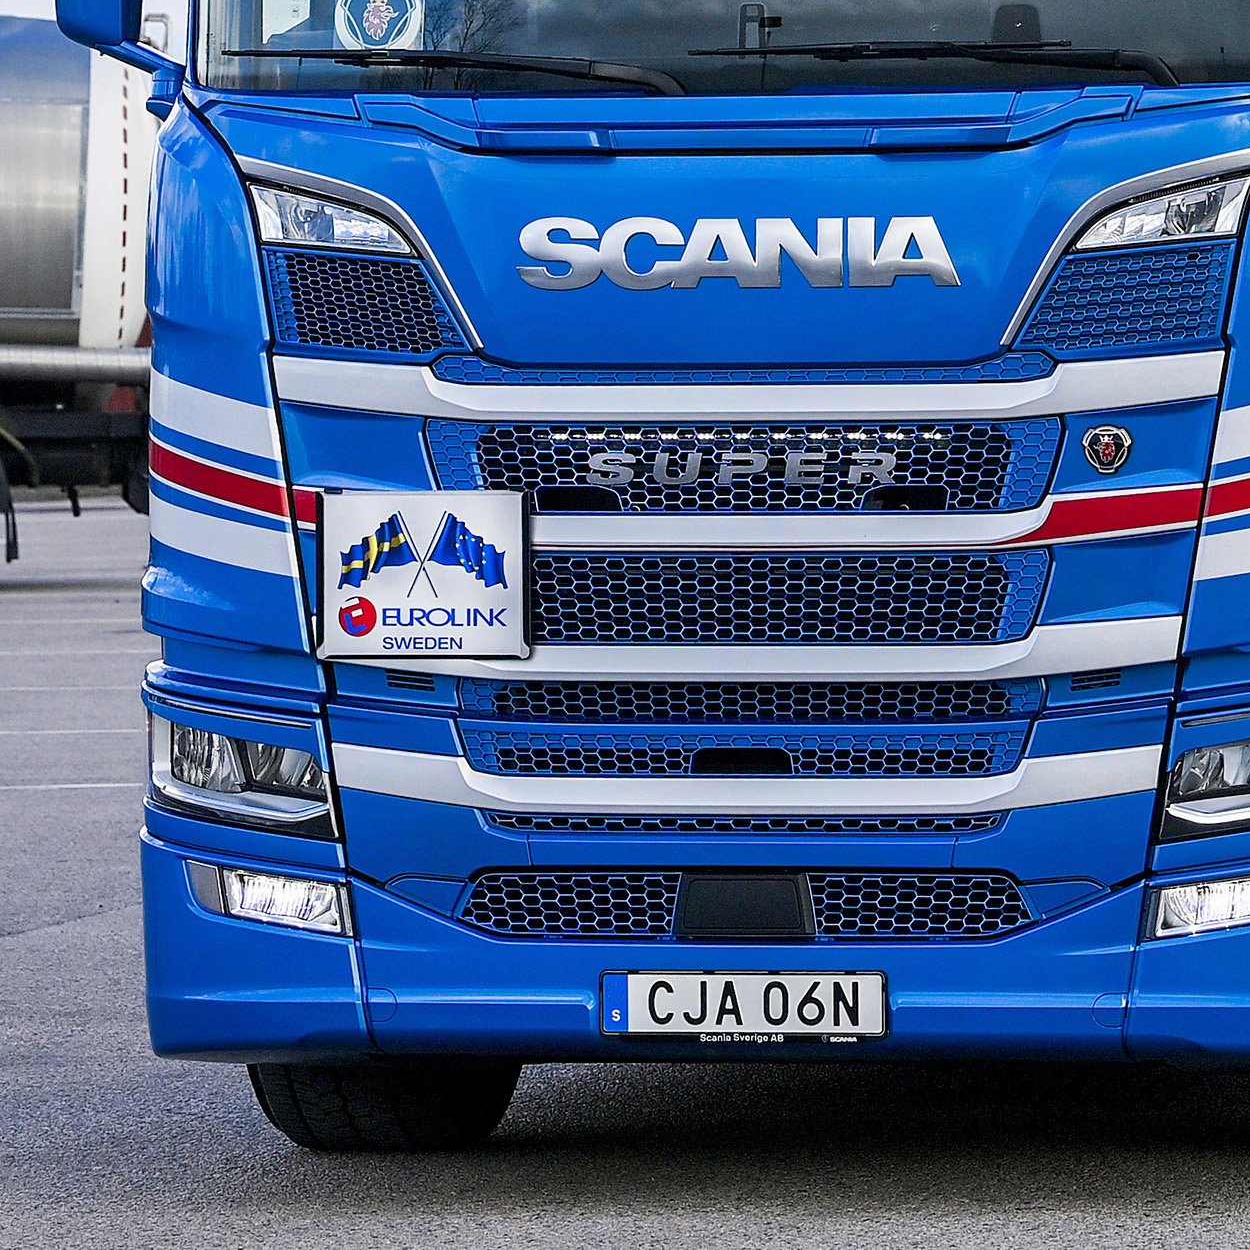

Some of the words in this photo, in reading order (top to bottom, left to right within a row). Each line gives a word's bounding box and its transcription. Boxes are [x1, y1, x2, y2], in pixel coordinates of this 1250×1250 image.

[516, 216, 961, 290] SCANIA
[586, 452, 897, 485] SUPER
[382, 608, 508, 627] EUROLINK
[382, 636, 463, 650] SWEDEN
[648, 980, 744, 1026] CJA
[763, 981, 860, 1027] 06N
[611, 1009, 621, 1022] S
[700, 1033, 731, 1042] Scania
[771, 1034, 785, 1042] AB
